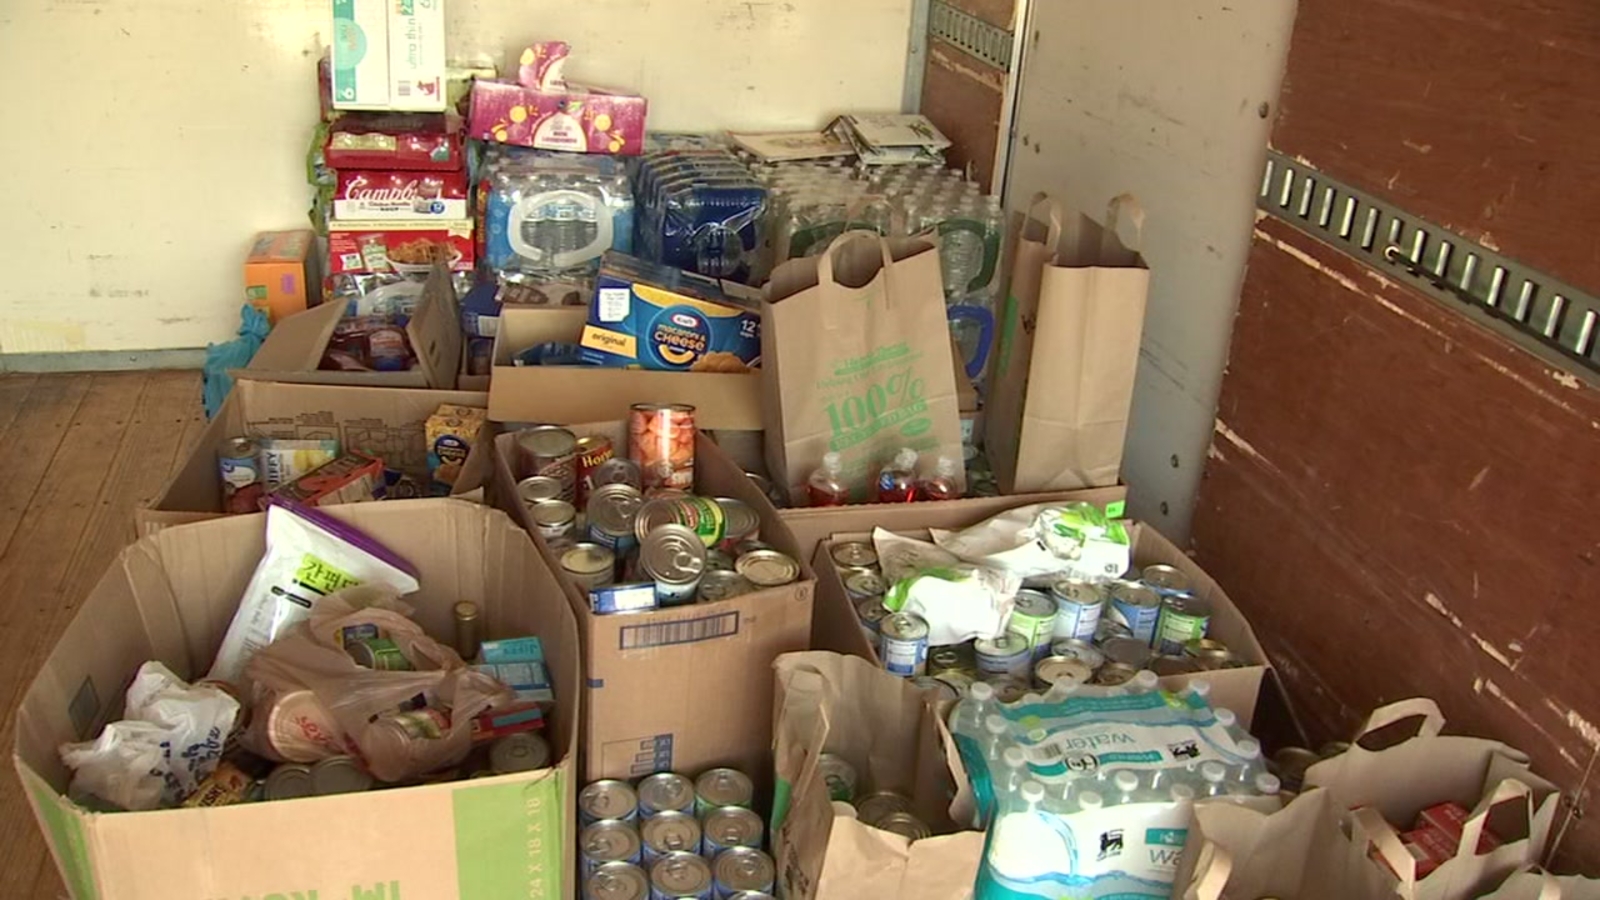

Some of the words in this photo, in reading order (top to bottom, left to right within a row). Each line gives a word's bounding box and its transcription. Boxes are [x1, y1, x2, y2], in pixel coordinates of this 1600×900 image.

[741, 319, 757, 333] 12
[591, 330, 627, 348] original
[822, 366, 925, 438] 100%
[1064, 731, 1137, 752] water
[526, 838, 542, 858] 18
[528, 878, 544, 898] 24
